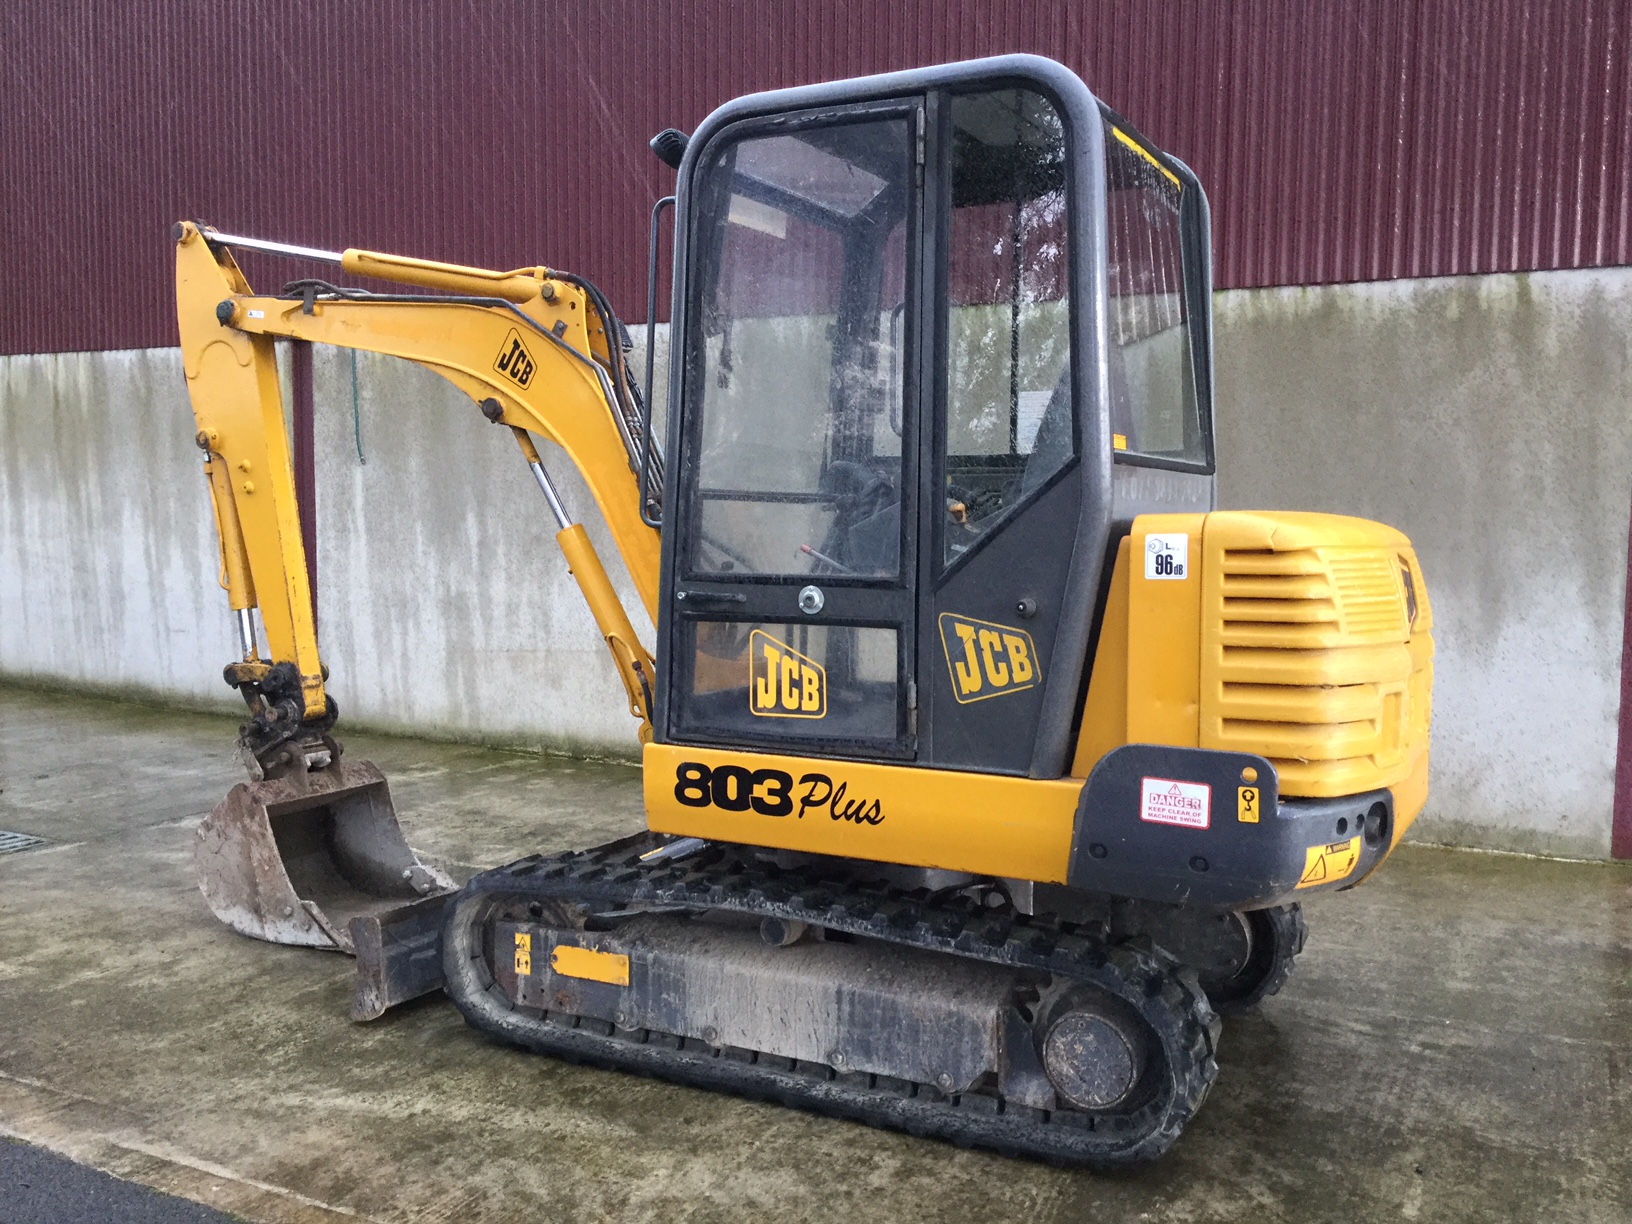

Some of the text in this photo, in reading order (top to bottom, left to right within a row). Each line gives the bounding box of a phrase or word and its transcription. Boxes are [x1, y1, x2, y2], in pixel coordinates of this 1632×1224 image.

[497, 338, 533, 385] JCB
[757, 643, 820, 711] JCB
[954, 622, 1033, 695] JCB
[674, 762, 885, 825] 803 Plus
[1148, 812, 1178, 821] MACHINE
[1150, 793, 1201, 810] DANGER
